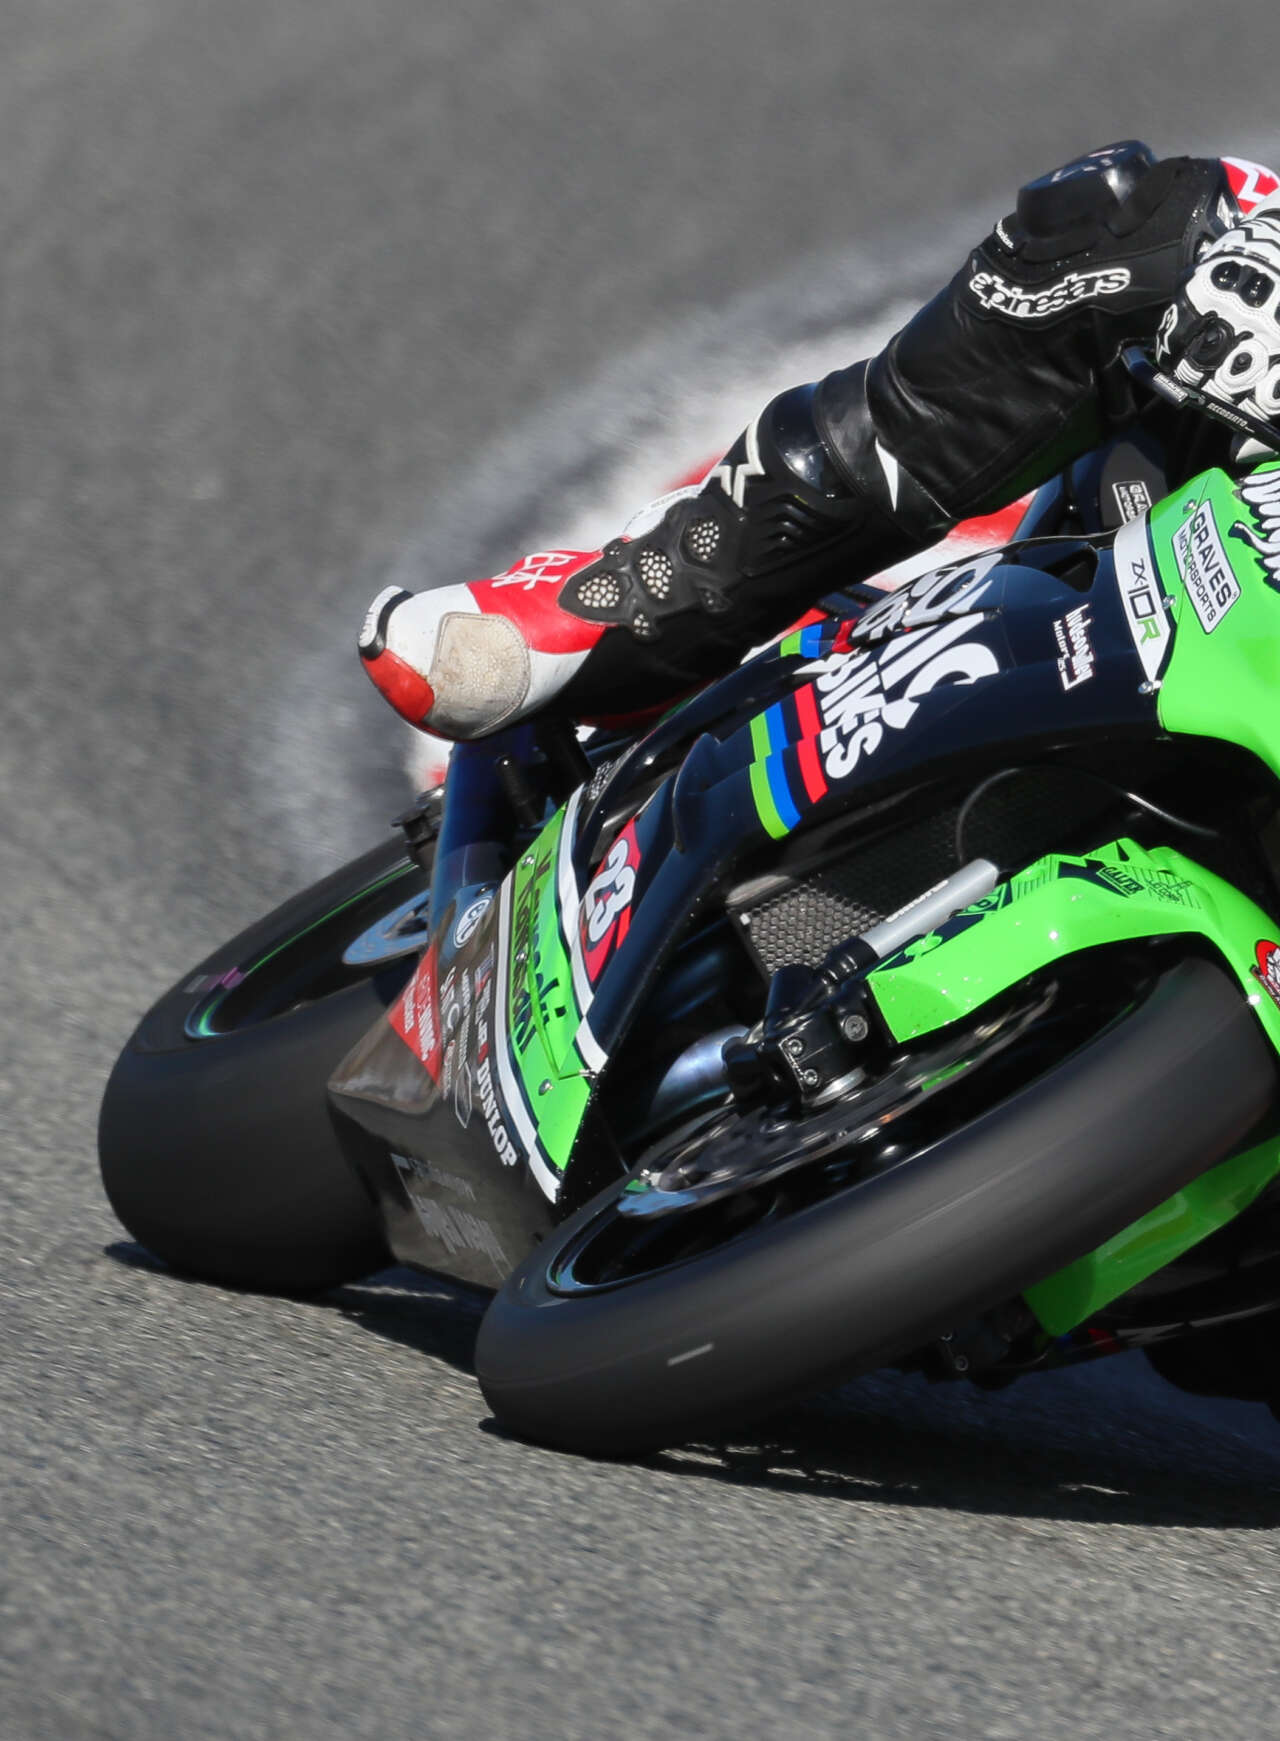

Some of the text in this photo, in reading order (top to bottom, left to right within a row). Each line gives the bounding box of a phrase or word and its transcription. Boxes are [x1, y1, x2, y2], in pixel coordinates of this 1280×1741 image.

[1130, 558, 1162, 645] ZX-10R
[1178, 531, 1216, 622] MOTORSPORTS
[1190, 512, 1233, 609] GRAVES
[586, 839, 636, 942] 23
[477, 1057, 518, 1167] DUNLOP
